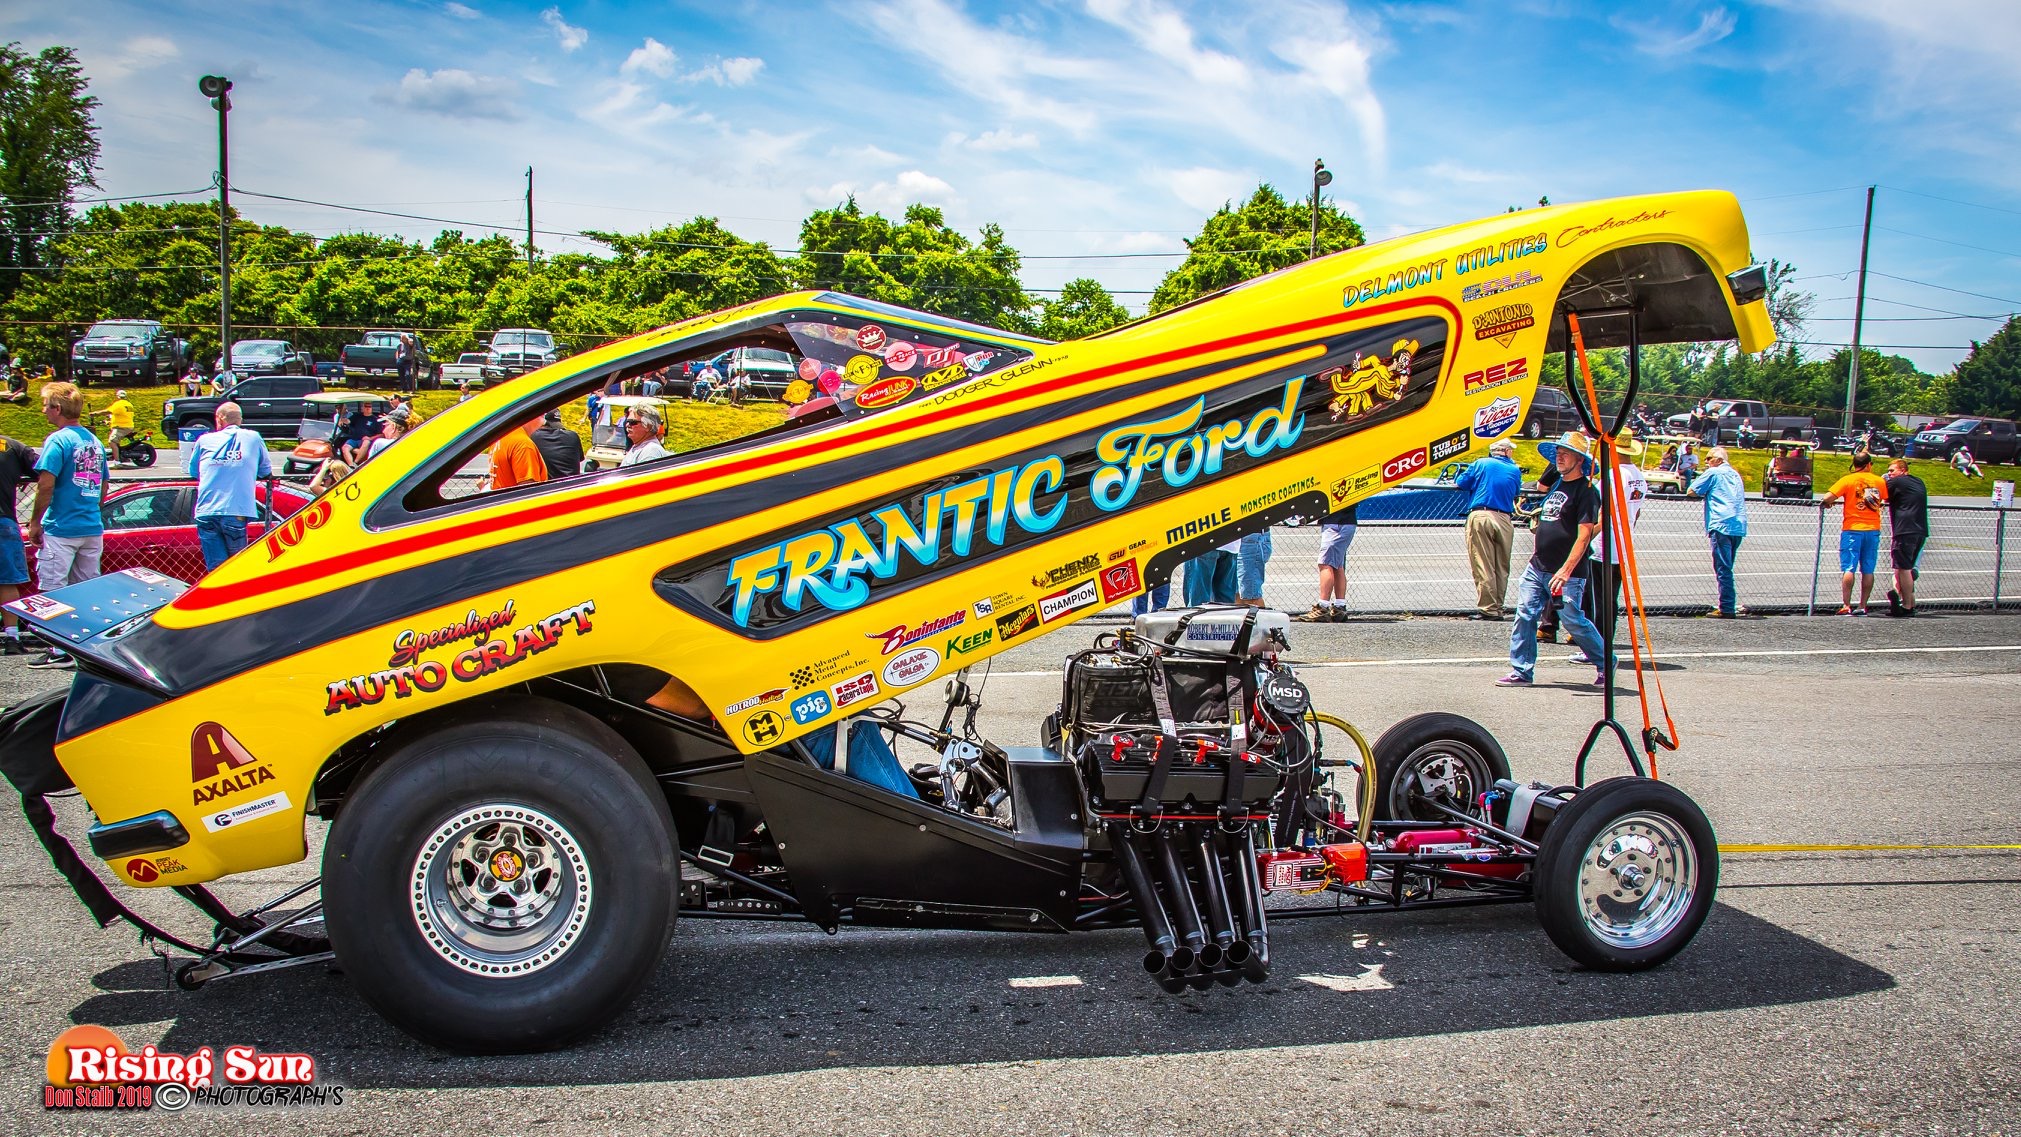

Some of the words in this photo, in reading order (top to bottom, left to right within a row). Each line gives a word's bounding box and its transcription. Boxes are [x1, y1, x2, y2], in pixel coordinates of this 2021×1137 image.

[1342, 258, 1448, 308] DELMONT
[1455, 232, 1548, 276] UTILITIES
[1556, 210, 1673, 248] Contractors
[1472, 303, 1534, 329] D'ANTONIO
[1477, 318, 1533, 339] EXCAVATING
[934, 379, 1007, 405] DODGER
[1000, 358, 1053, 381] GLENN
[1463, 357, 1528, 391] REZ
[1475, 427, 1486, 435] OIL
[1487, 416, 1516, 431] PRODUCTS
[1479, 405, 1518, 427] LUCAS
[1432, 441, 1451, 453] TUB
[1432, 440, 1468, 460] TOWELS
[1383, 451, 1425, 479] CRC
[1332, 477, 1354, 497] S&P
[1354, 471, 1379, 485] Racing
[1354, 481, 1369, 491] Tees
[728, 453, 1070, 629] FRANTIC
[1089, 375, 1308, 513] Ford
[1240, 491, 1277, 515] MONSTER
[1165, 507, 1232, 545] MAHLE
[1108, 549, 1126, 561] GW
[1128, 539, 1147, 550] GEAR
[1050, 552, 1100, 583] PHENIX
[993, 591, 1008, 601] TOWN
[1043, 587, 1096, 615] CHAMPION
[974, 602, 993, 613] TSR
[388, 599, 517, 667] Specialized
[945, 628, 993, 660] KEEN
[324, 660, 448, 717] AUTO
[451, 598, 597, 683] CRAFT
[813, 650, 851, 669] Advanced
[855, 659, 870, 667] Inc.
[892, 651, 928, 671] GALAXIE
[814, 662, 838, 676] Metal
[836, 674, 875, 695] ISC
[1272, 687, 1302, 698] MSD
[796, 696, 828, 722] pig
[192, 765, 276, 807] AXALTA
[156, 858, 181, 869] PEAK
[160, 864, 188, 875] MEDIA
